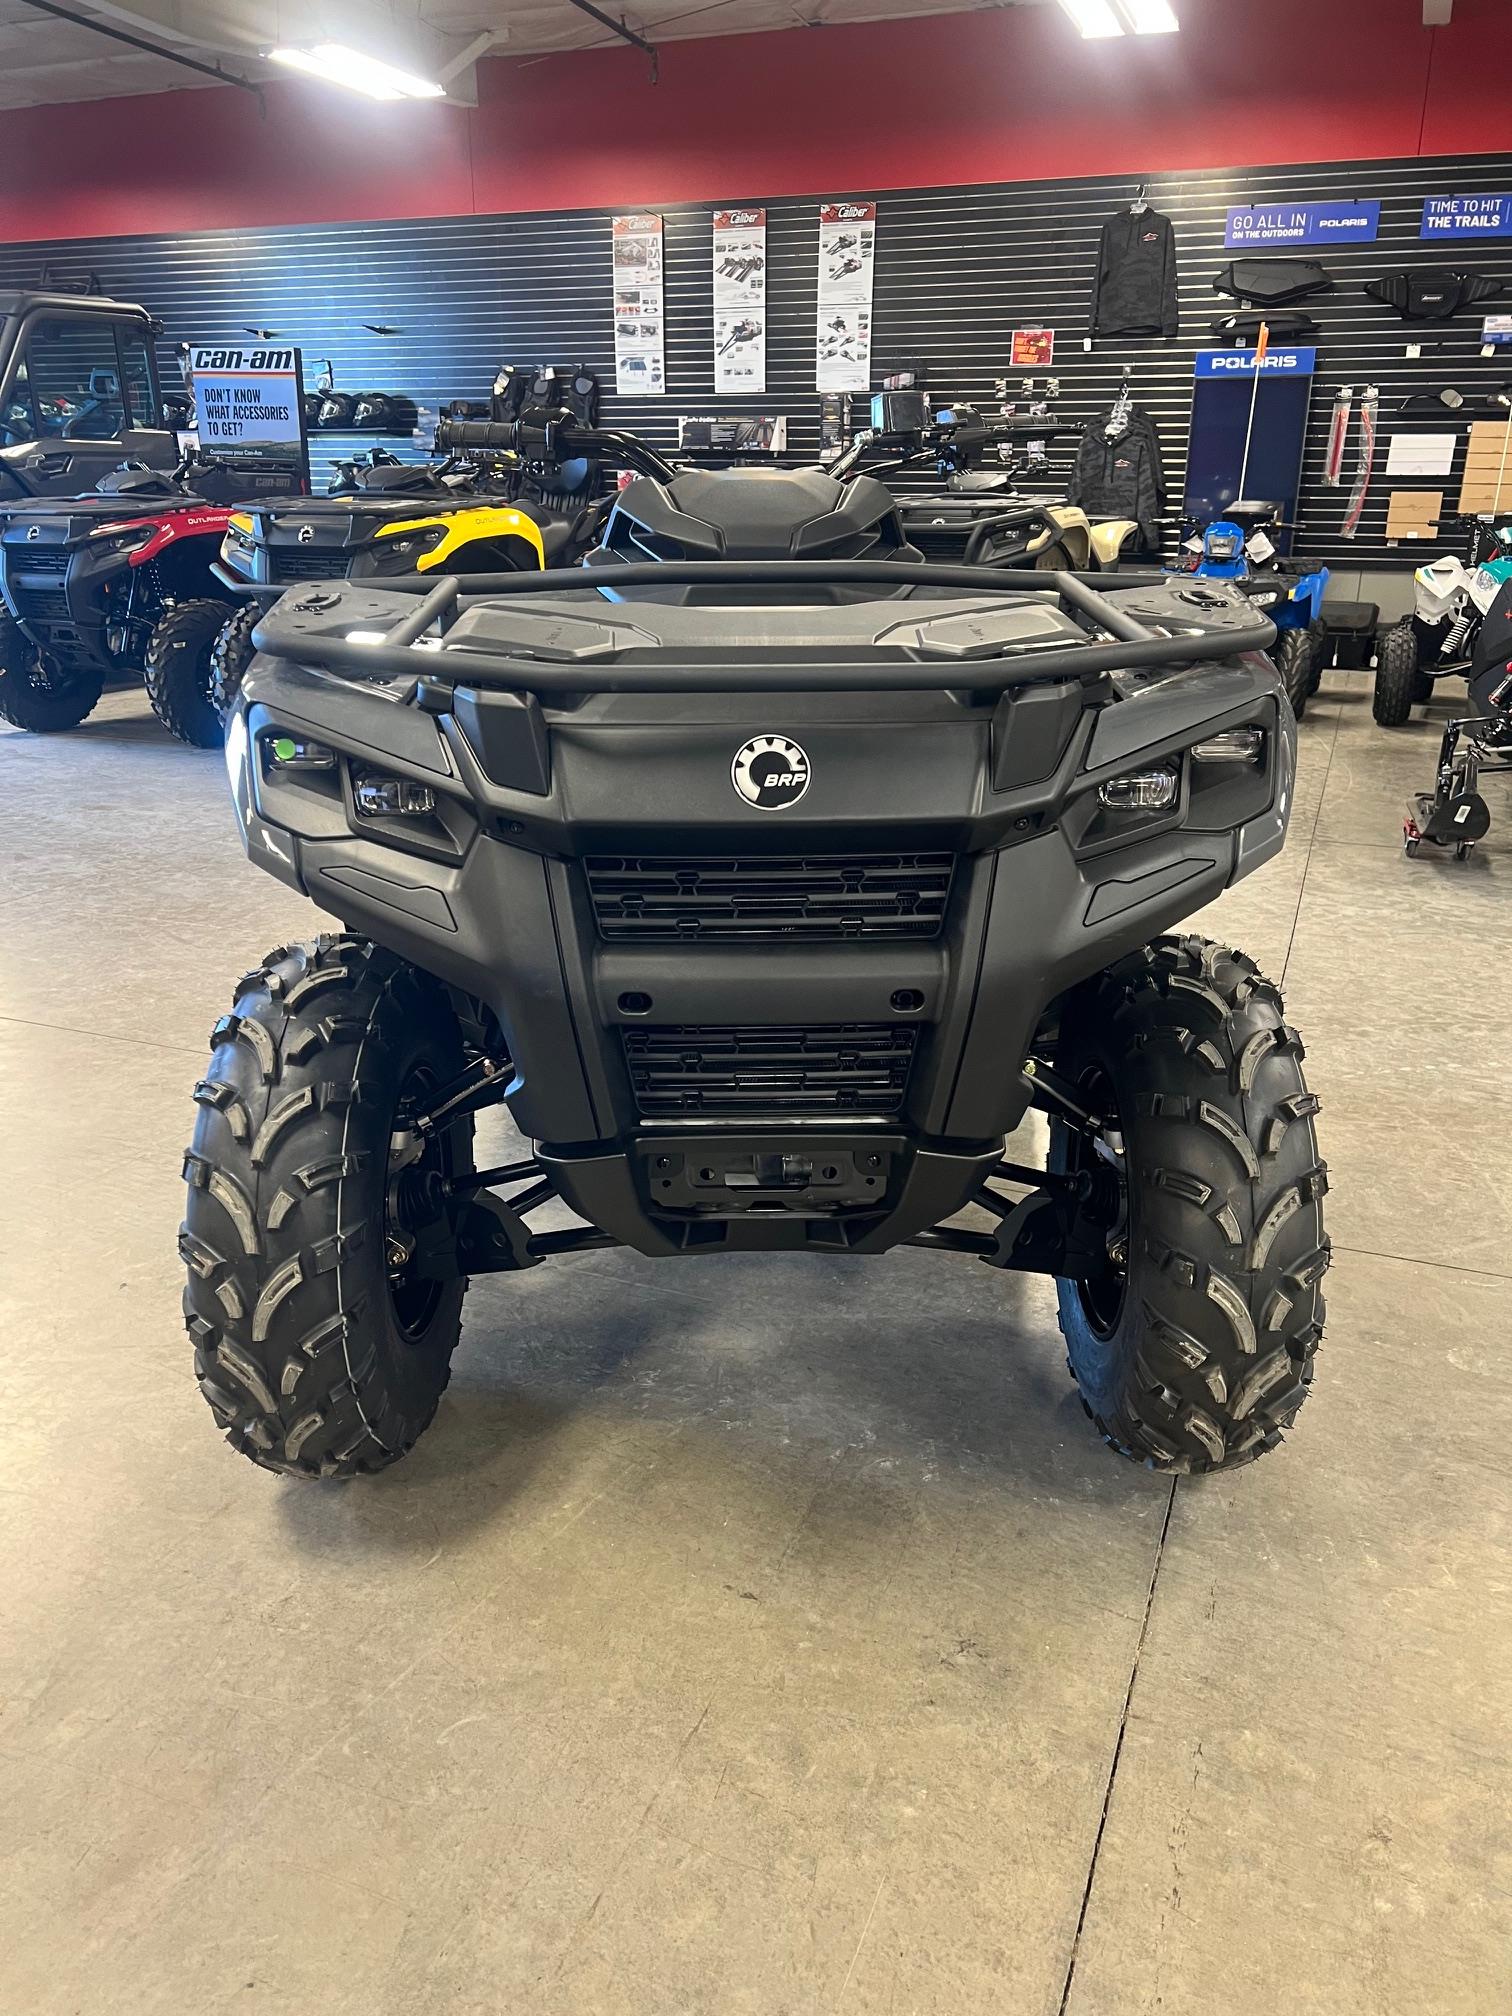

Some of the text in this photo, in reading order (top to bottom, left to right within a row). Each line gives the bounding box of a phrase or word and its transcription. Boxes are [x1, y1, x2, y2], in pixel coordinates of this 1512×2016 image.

[838, 206, 869, 218] Caliber
[1429, 199, 1503, 213] TIME TO HIT
[730, 212, 758, 224] Caliber
[1233, 212, 1307, 229] GO ALL IN
[1319, 218, 1368, 228] POLARIS
[1427, 214, 1501, 228] THE TRAILS
[1232, 228, 1305, 239] ON THE OUTDOORS
[1211, 355, 1297, 370] POLARIS
[204, 388, 261, 403] DON'T KNOW
[205, 405, 289, 421] WHAT ACCESSORIES
[208, 421, 243, 436] TO GET?
[1470, 528, 1481, 566] HELMET
[763, 773, 807, 788] BRP
